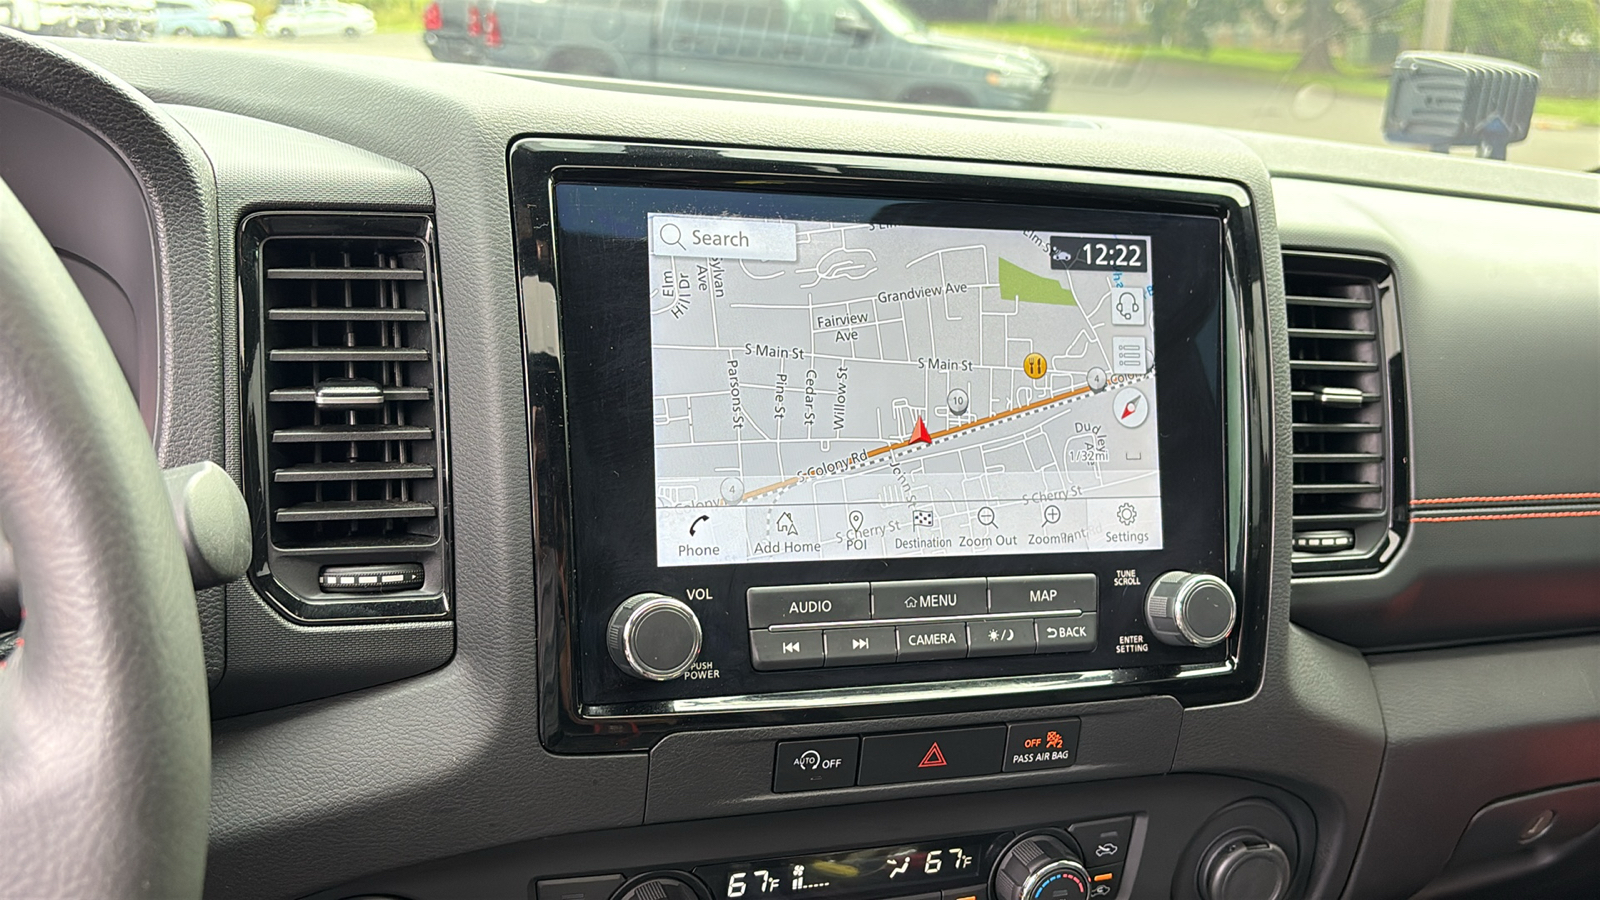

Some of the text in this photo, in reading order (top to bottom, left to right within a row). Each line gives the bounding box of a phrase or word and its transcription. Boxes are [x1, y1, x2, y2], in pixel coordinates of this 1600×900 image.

[692, 230, 750, 248] Search
[1082, 243, 1142, 267] 12:22
[662, 270, 674, 297] Elm
[696, 264, 708, 291] Ave
[671, 273, 691, 319] Hill Dr
[877, 281, 968, 304] Grandview Ave
[817, 313, 869, 328] Fairview
[835, 329, 859, 343] Ave
[744, 343, 805, 360] S Main St
[917, 358, 974, 372] S Main St
[1094, 374, 1100, 383] 4
[727, 359, 744, 430] Parsons St
[774, 373, 788, 419] Pine St
[804, 369, 818, 426] Cedar St
[833, 366, 849, 431] Willow St
[952, 396, 964, 406] 10
[1074, 422, 1107, 453] Dudley
[796, 449, 867, 482] S Colony Rd
[729, 485, 736, 495] 4
[1022, 485, 1083, 506] S Cherry St
[888, 520, 902, 532] St
[895, 536, 952, 549] Destination
[959, 534, 1018, 547] Zoom Out
[1028, 534, 1060, 545] Zoom
[1106, 531, 1149, 544] Settings
[678, 545, 720, 557] Phone
[754, 541, 821, 554] Add Home
[846, 539, 867, 551] POI
[1116, 570, 1136, 578] TUNE
[1113, 577, 1141, 586] SCROLL
[686, 588, 713, 601] VOL
[919, 594, 958, 608] MENU
[1029, 590, 1058, 602] MAP
[789, 600, 832, 614] AUDIO
[1059, 626, 1087, 638] BACK
[908, 633, 957, 646] CAMERA
[1119, 635, 1144, 644] ENTER
[1115, 643, 1149, 653] SETTING
[690, 662, 713, 670] PUSH
[684, 669, 721, 680] POWER
[1024, 738, 1042, 748] OFF
[793, 757, 842, 769] AUTO OFF
[1012, 750, 1069, 763] PASS AIR BAG
